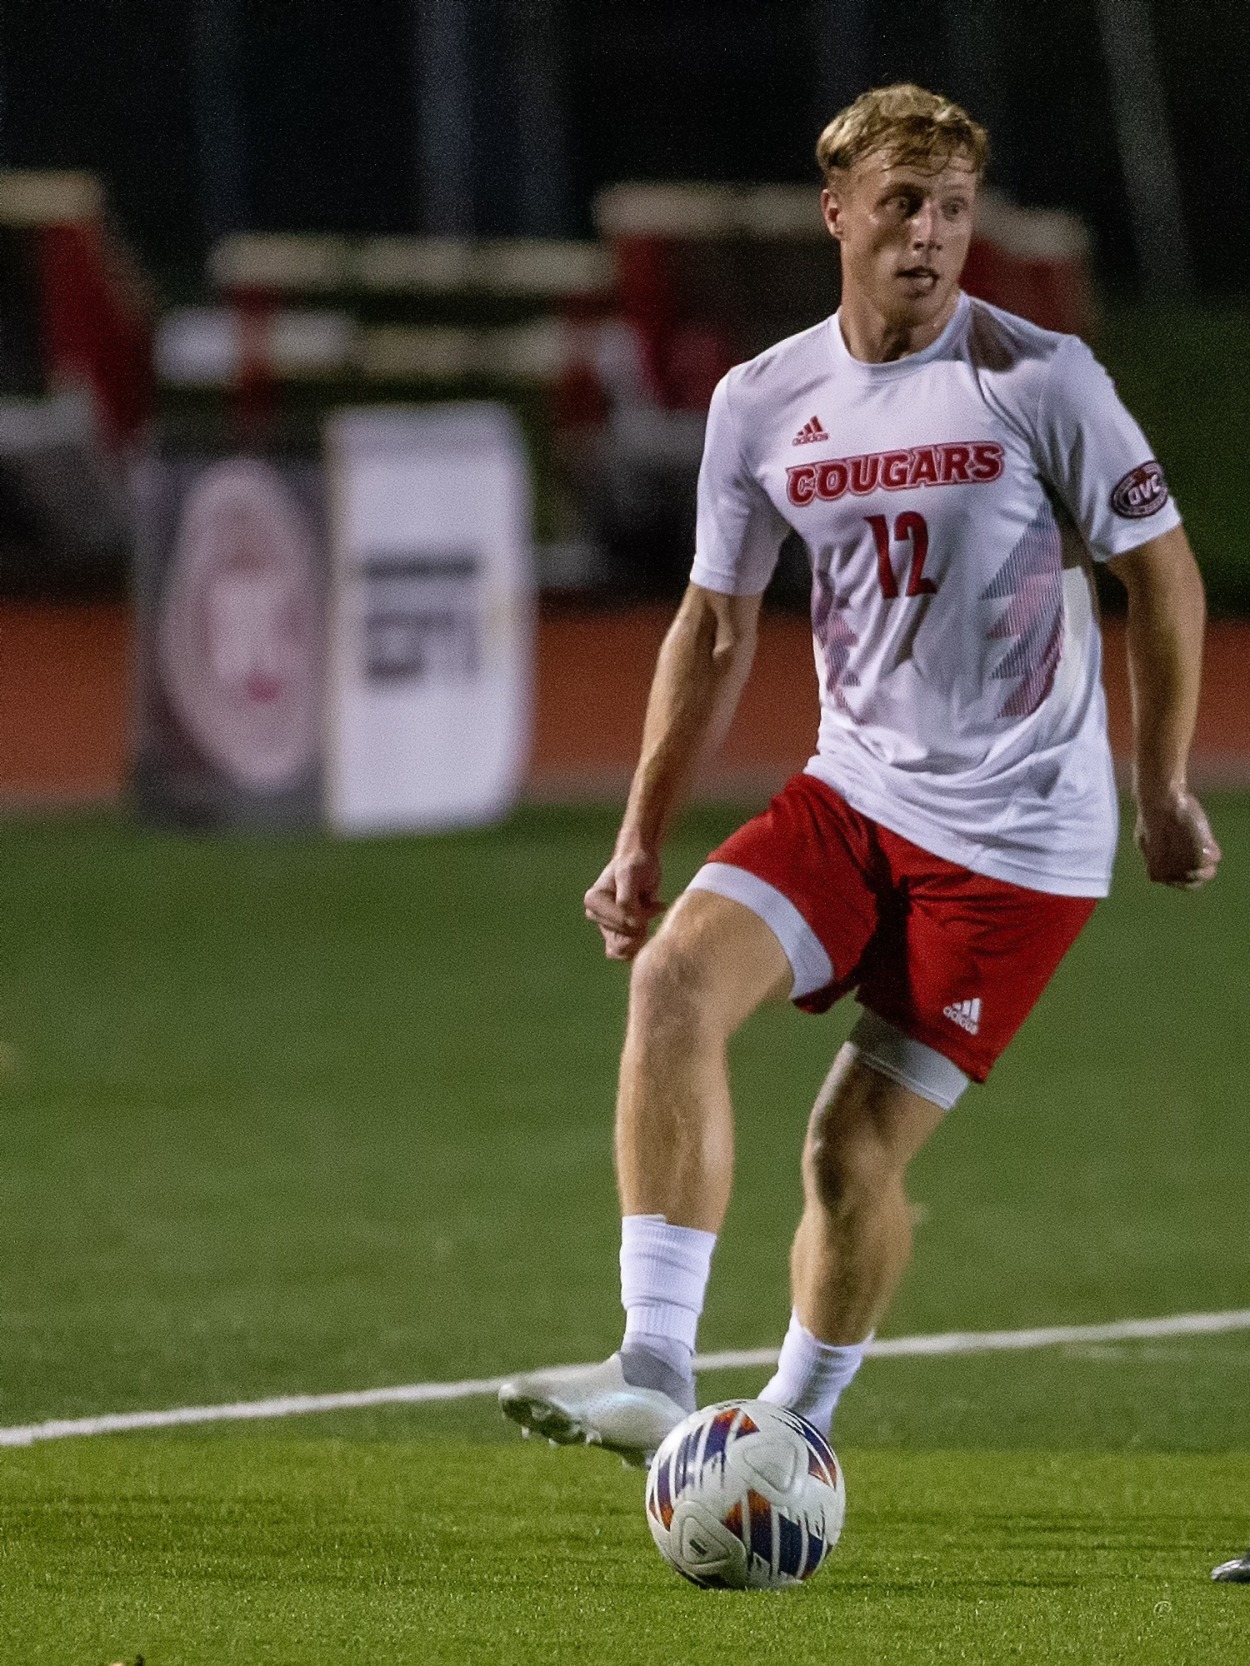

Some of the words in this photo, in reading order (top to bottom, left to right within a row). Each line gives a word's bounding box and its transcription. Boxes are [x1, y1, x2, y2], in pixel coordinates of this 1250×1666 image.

[792, 433, 828, 446] adidas
[785, 441, 1004, 507] COUGARS
[864, 511, 938, 600] 12
